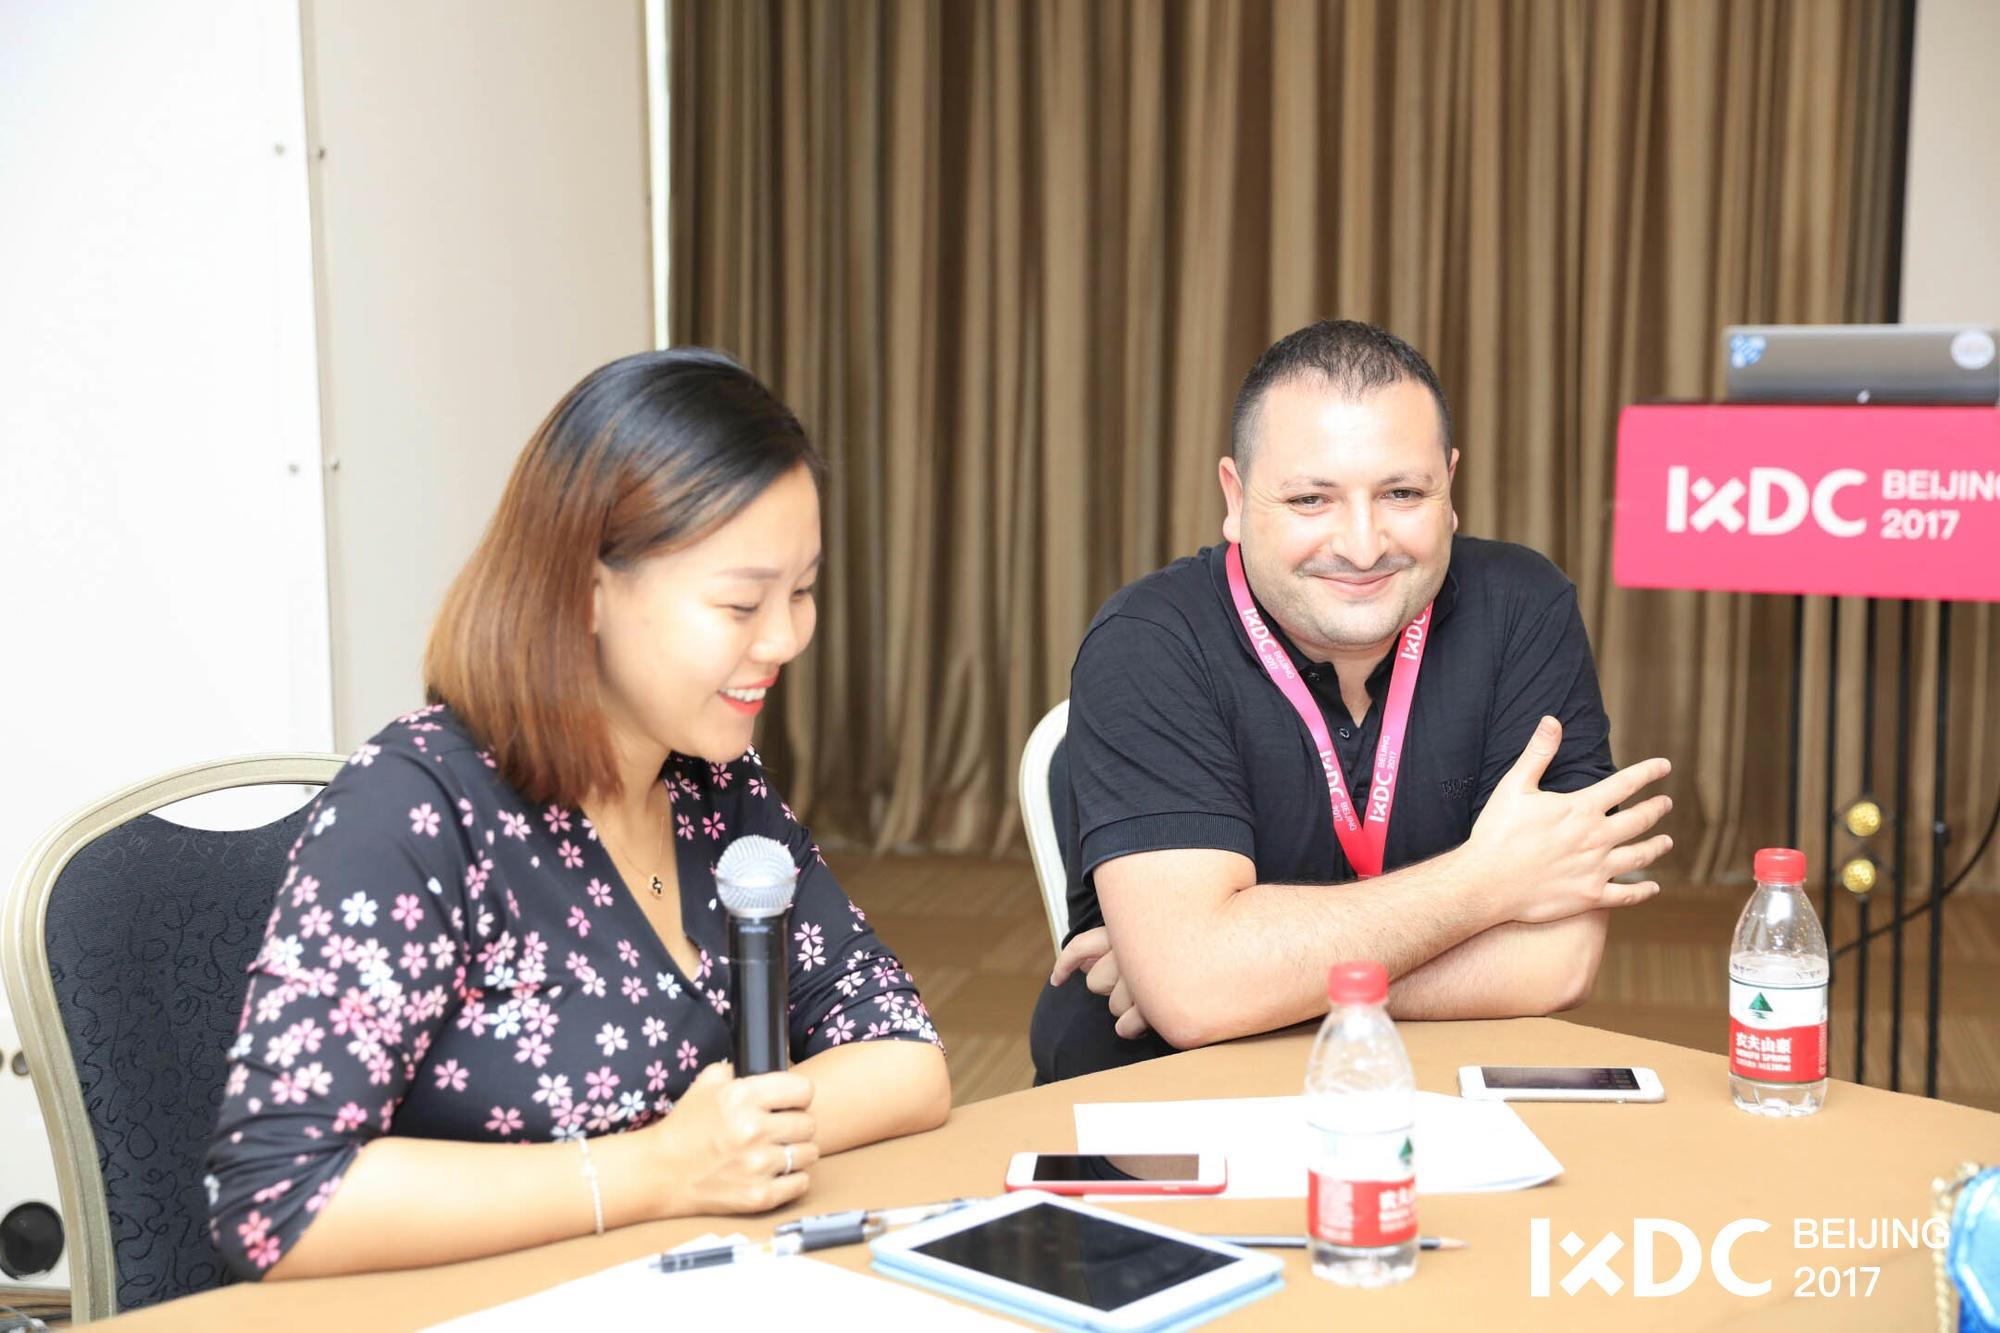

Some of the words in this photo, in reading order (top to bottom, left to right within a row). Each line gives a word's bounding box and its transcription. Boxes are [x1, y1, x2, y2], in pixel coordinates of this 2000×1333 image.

[1882, 469, 2000, 501] BEIJIN
[1880, 508, 1960, 540] 2017
[1264, 654, 1280, 670] 2017
[1274, 649, 1295, 679] BEIJING
[1377, 735, 1391, 768] BEIJING
